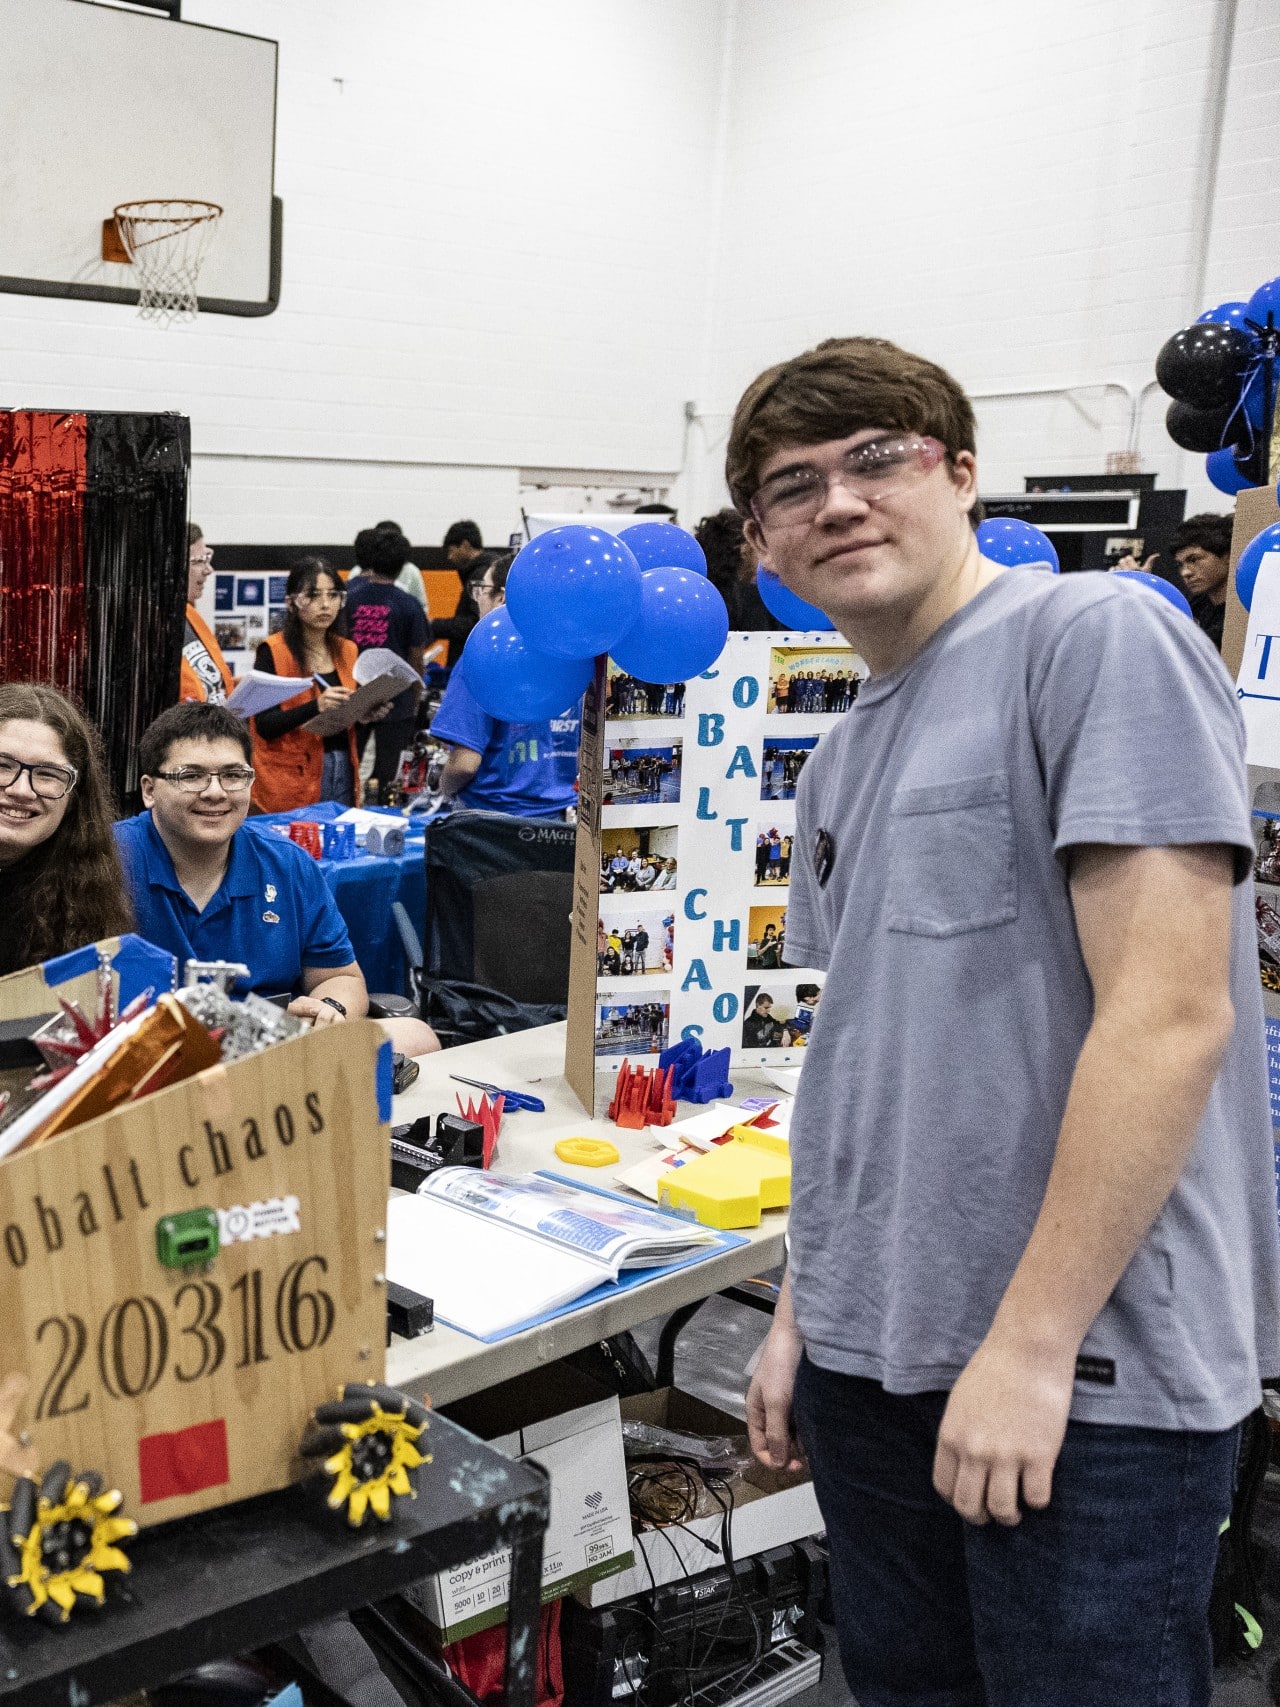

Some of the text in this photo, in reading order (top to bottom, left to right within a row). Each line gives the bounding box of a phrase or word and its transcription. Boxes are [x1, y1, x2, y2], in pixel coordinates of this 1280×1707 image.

[695, 669, 760, 852] OBALT
[178, 1090, 325, 1188] chaos
[34, 1254, 336, 1423] 20316
[449, 1568, 474, 1583] copy
[482, 1554, 506, 1574] print
[588, 1549, 613, 1565] NO JAM
[454, 1597, 471, 1611] 5000
[477, 1591, 486, 1601] 10
[492, 1584, 501, 1595] 20
